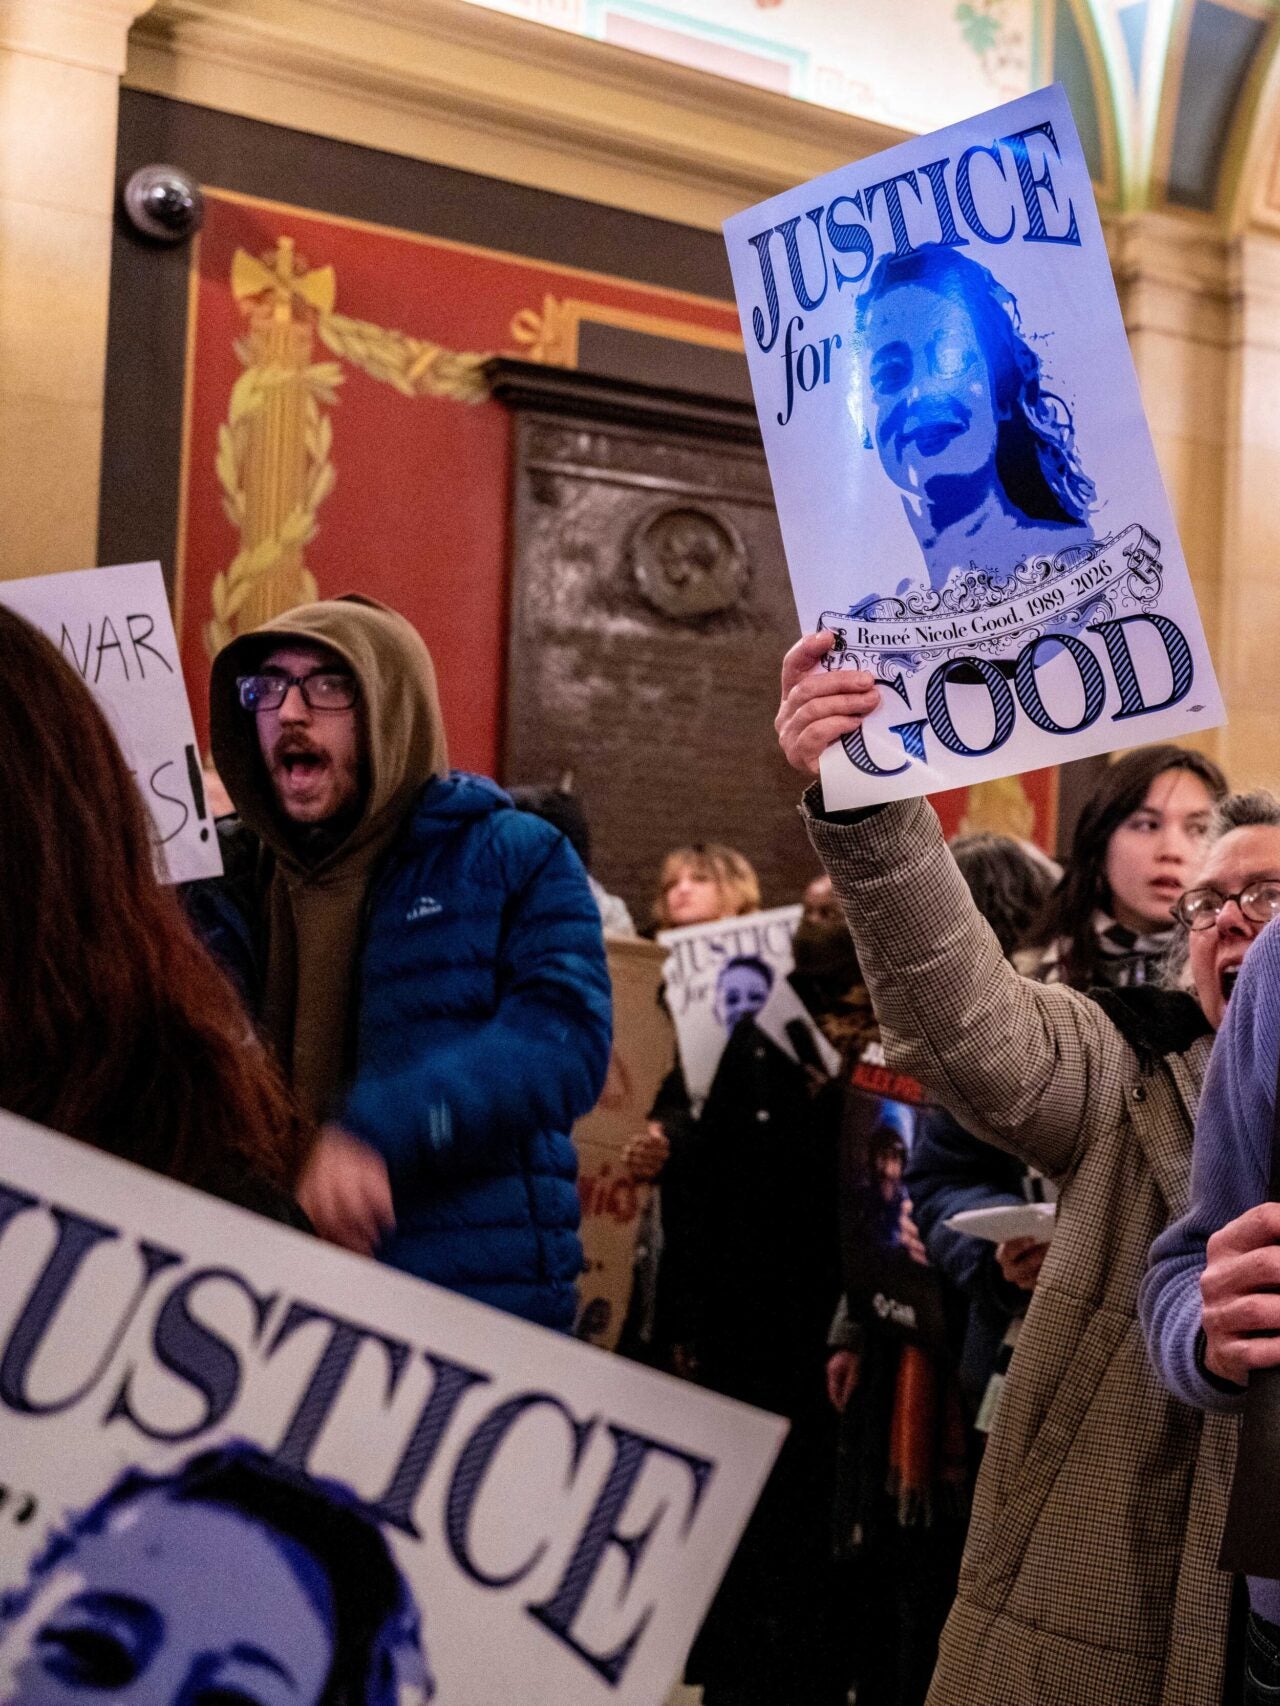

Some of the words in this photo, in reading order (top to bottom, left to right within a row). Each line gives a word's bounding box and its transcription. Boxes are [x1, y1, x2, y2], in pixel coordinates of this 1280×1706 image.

[748, 121, 1082, 353] JUSTICE
[777, 316, 842, 426] for
[857, 626, 911, 646] Reneé
[915, 624, 967, 642] Nicole
[971, 606, 1024, 635] Good,
[840, 613, 1194, 777] GOOD
[672, 920, 792, 984] JUSTIC
[0, 1183, 718, 1689] USTICE
